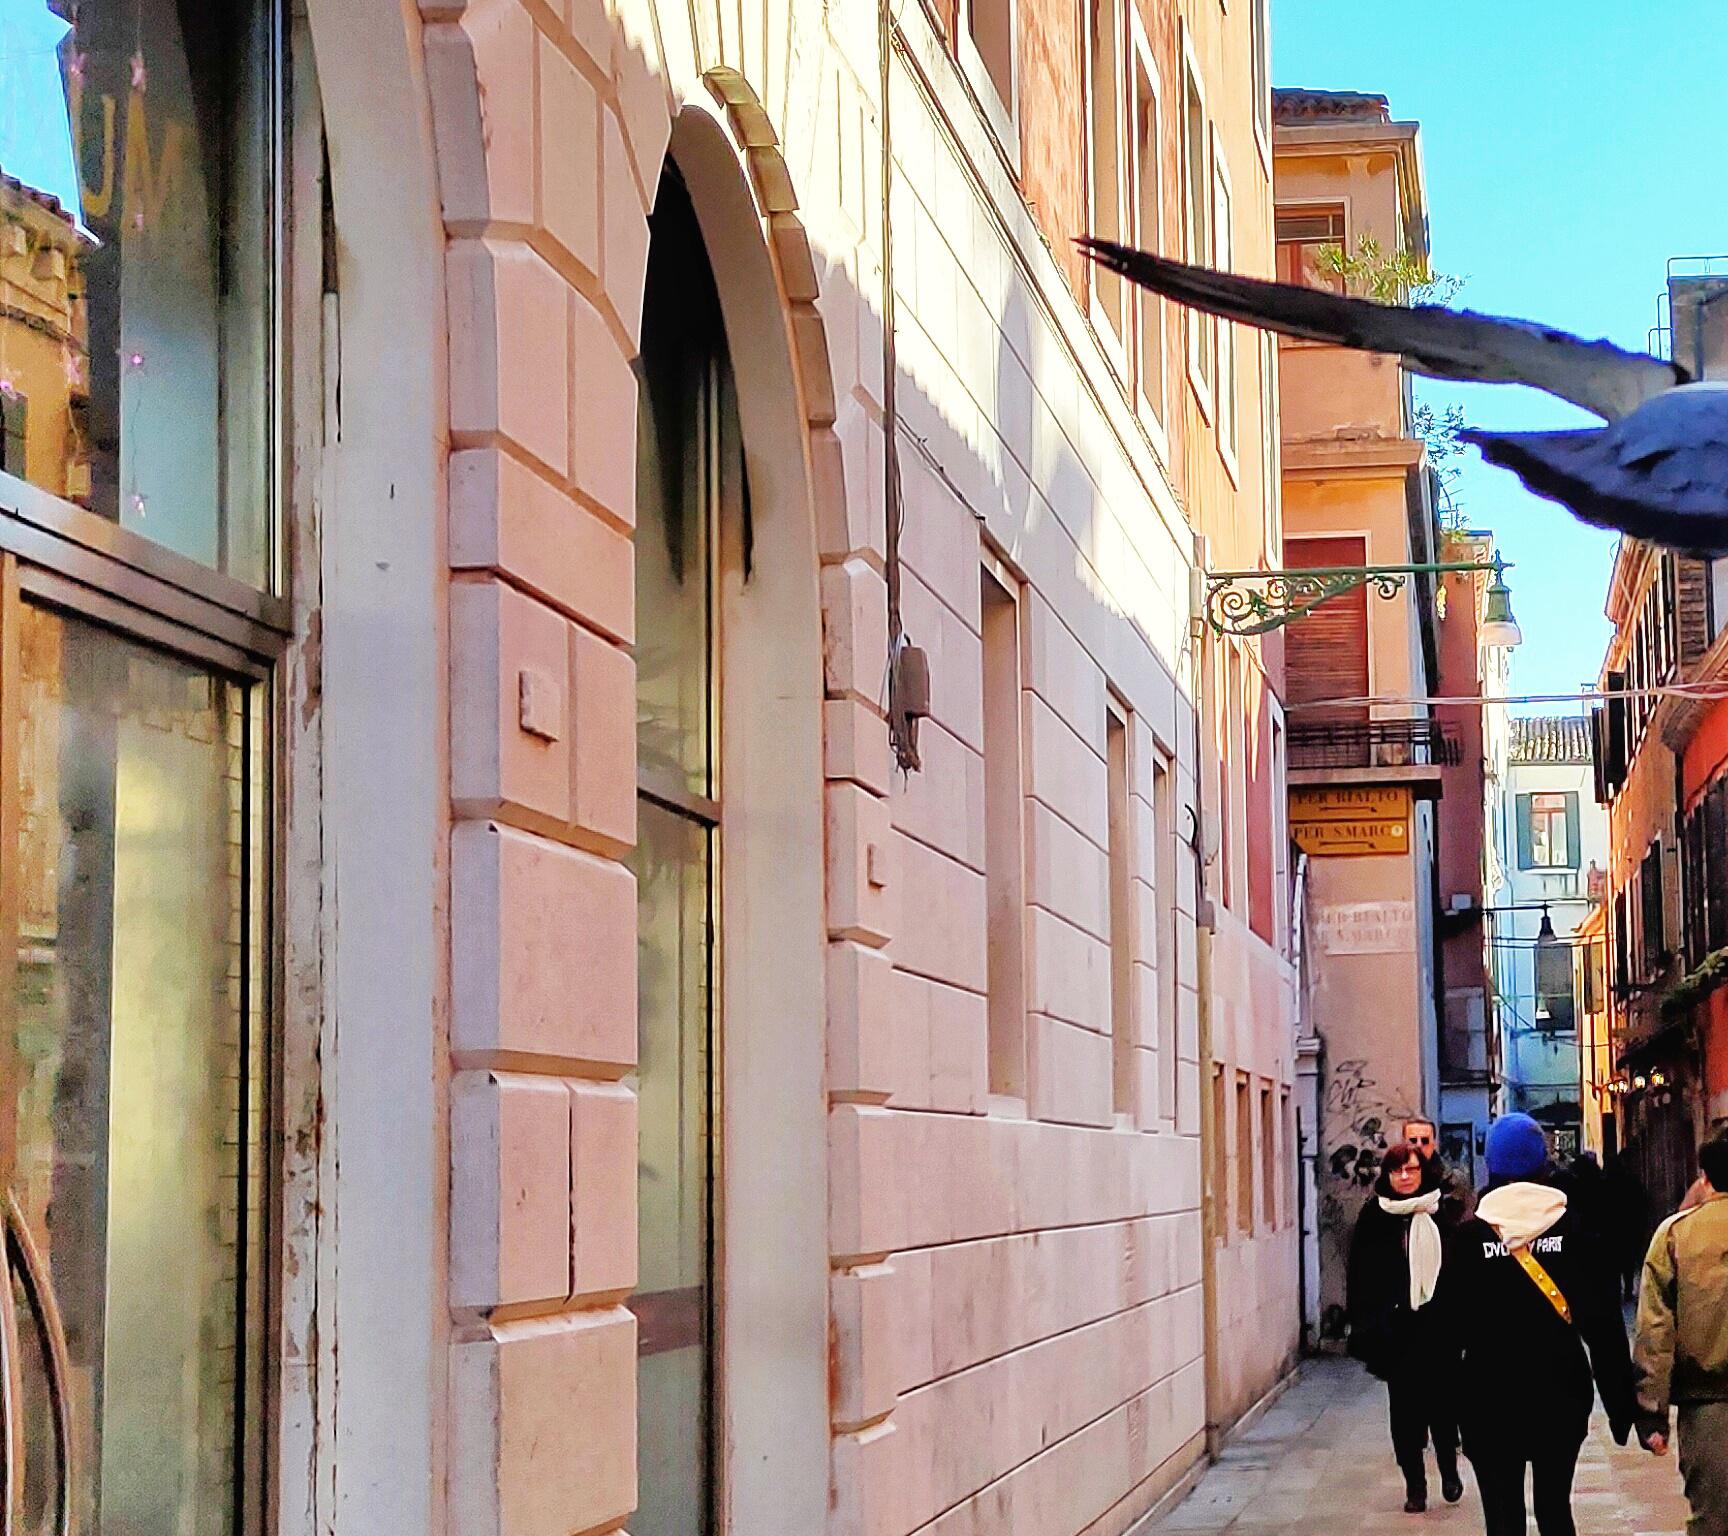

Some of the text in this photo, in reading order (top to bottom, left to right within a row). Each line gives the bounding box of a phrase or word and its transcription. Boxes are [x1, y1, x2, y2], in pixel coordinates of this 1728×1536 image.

[1296, 790, 1398, 804] PER RIALTO
[1294, 826, 1325, 839] PER
[1353, 908, 1412, 924] RIALTO
